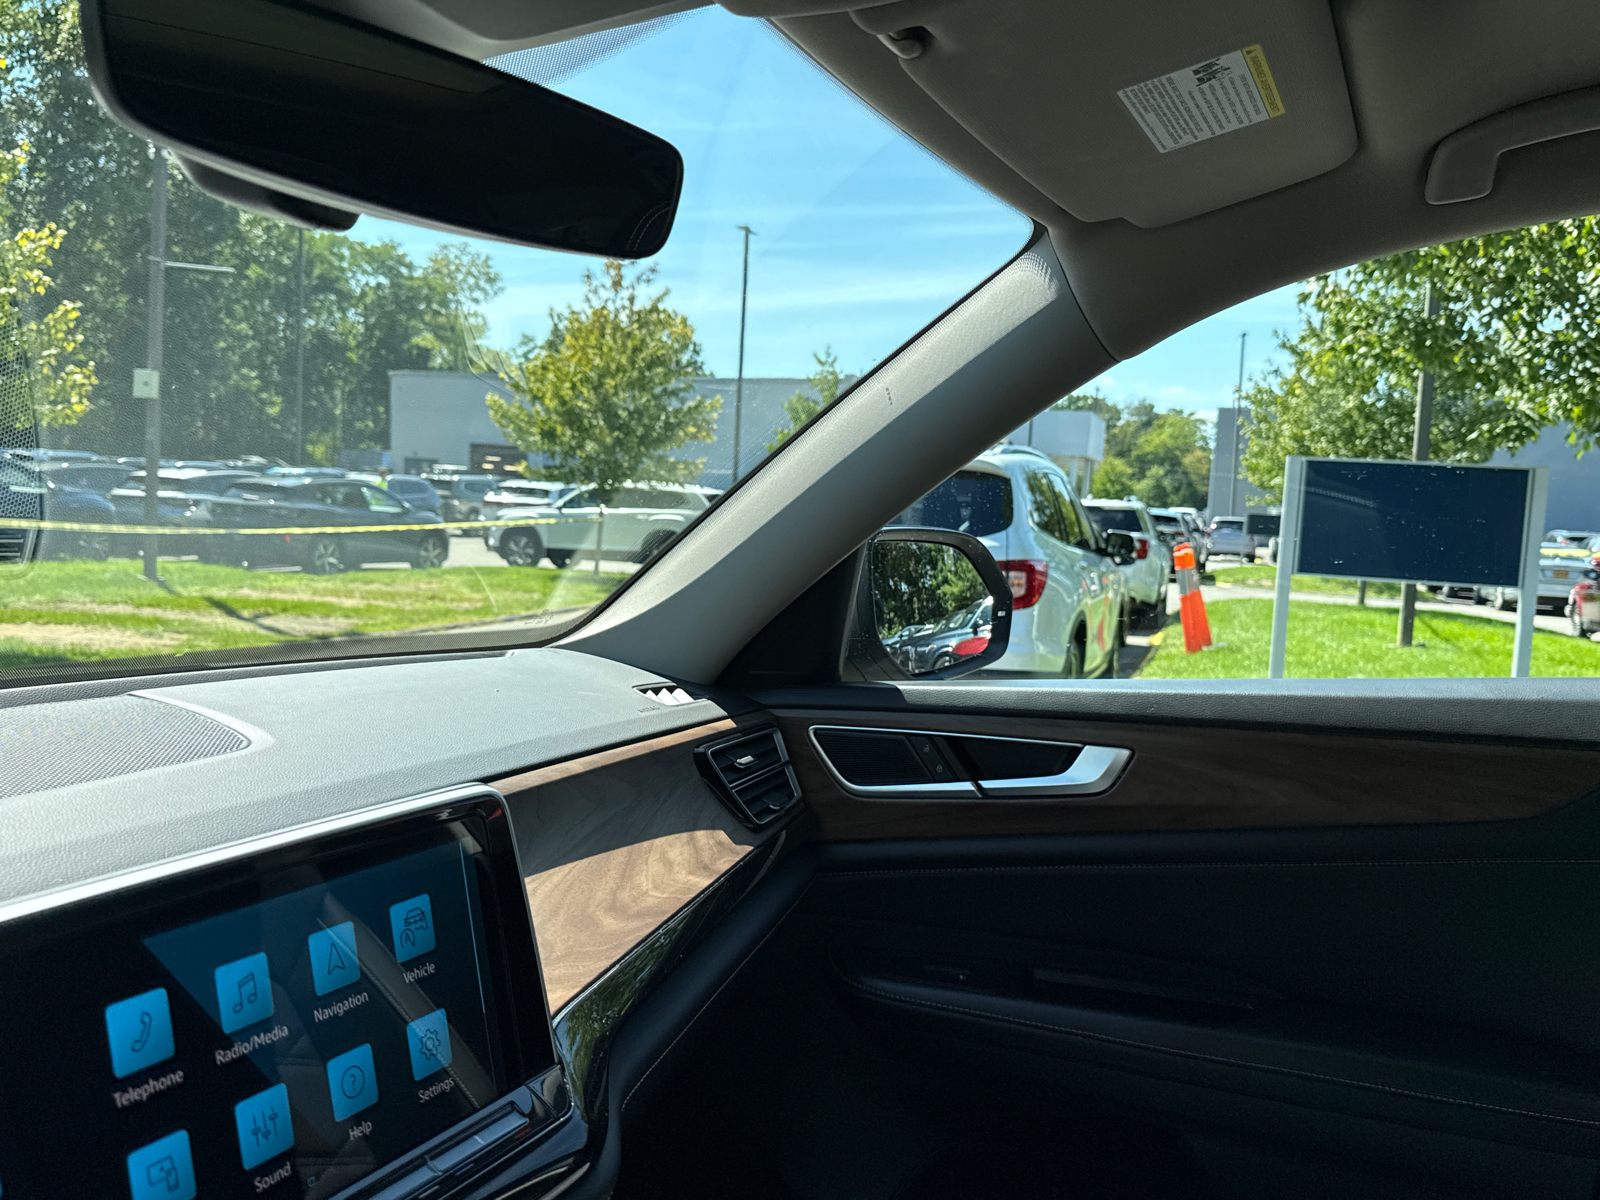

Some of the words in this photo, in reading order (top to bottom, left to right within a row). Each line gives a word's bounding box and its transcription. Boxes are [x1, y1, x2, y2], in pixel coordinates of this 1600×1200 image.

[403, 962, 435, 984] Vehicle
[313, 991, 369, 1023] Navigation
[214, 1024, 289, 1066] Radio/Media
[111, 1070, 185, 1109] Telephone
[418, 1077, 455, 1103] Settings
[348, 1120, 373, 1141] Help
[253, 1160, 292, 1194] Sound
